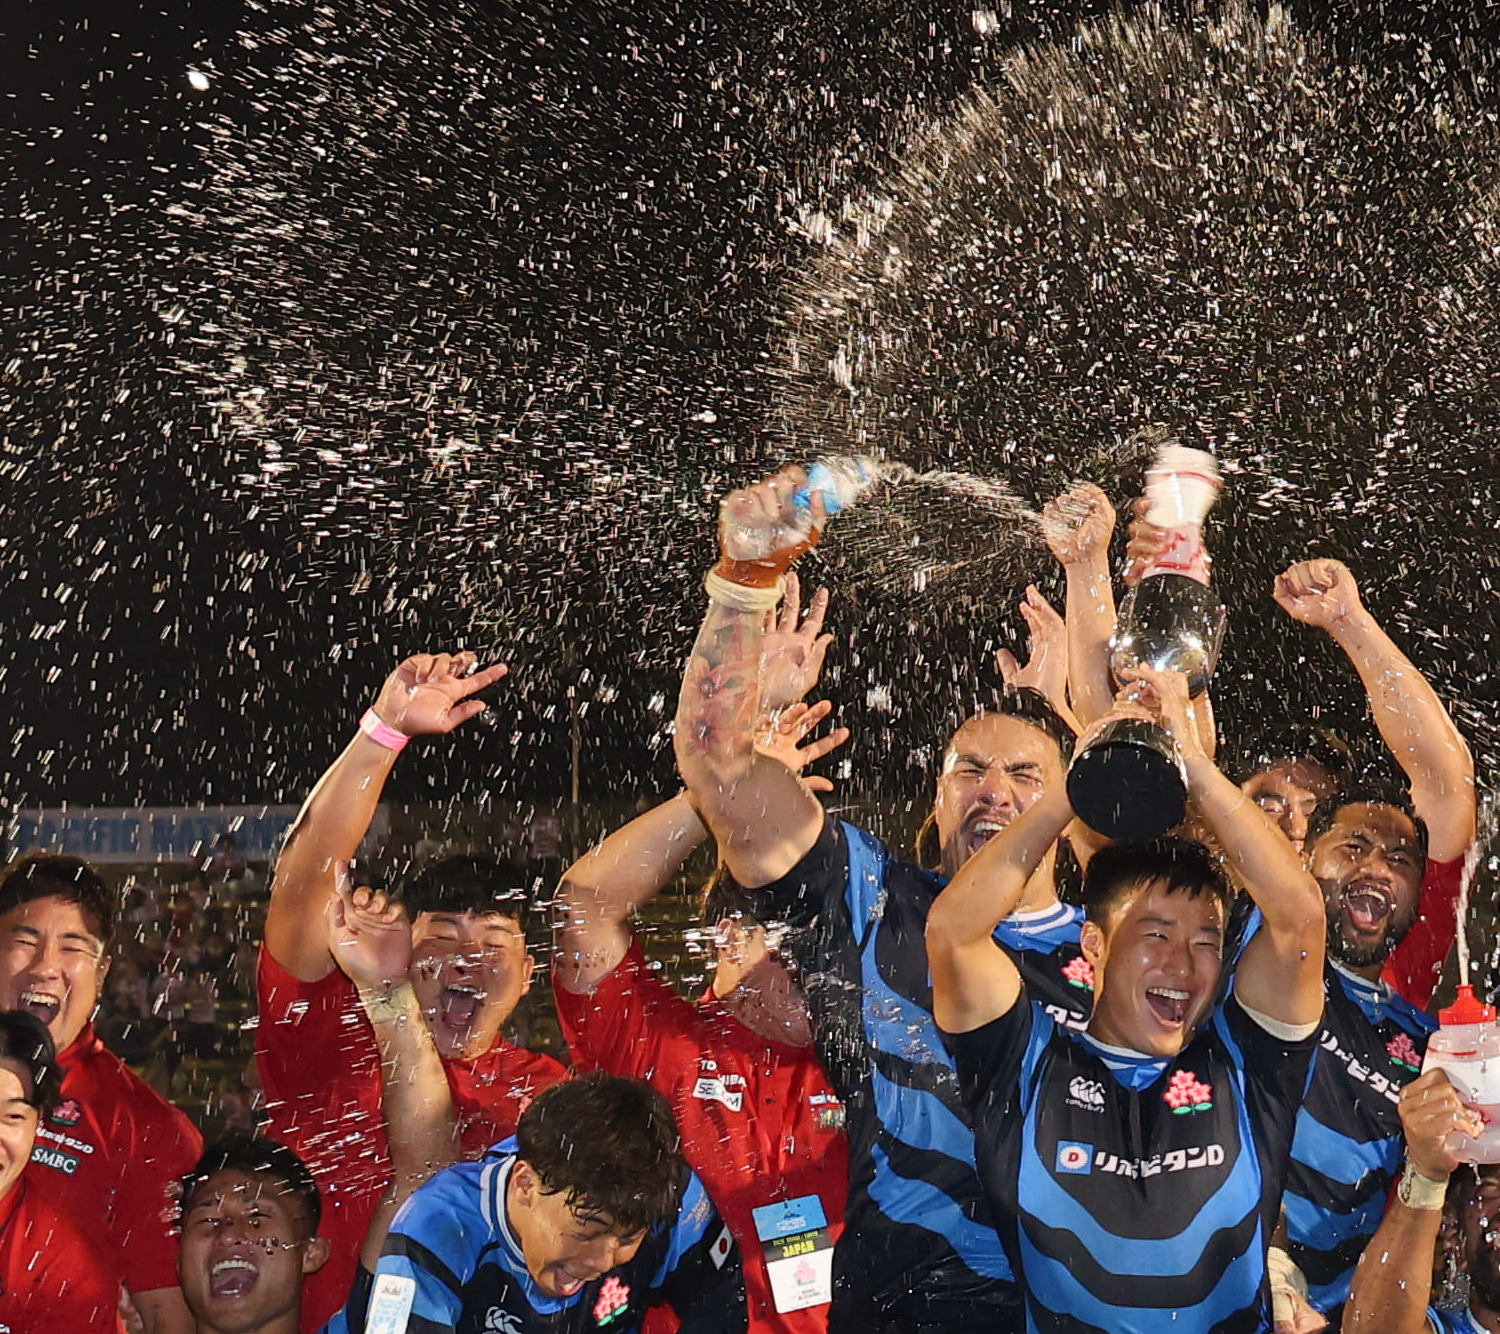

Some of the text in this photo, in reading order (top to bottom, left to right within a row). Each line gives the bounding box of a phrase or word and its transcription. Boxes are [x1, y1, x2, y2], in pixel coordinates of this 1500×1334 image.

[1065, 1097, 1105, 1114] canterbury
[31, 1148, 77, 1174] SMBC
[1094, 1144, 1225, 1180] リポビタンD
[782, 1240, 816, 1258] JAPAN
